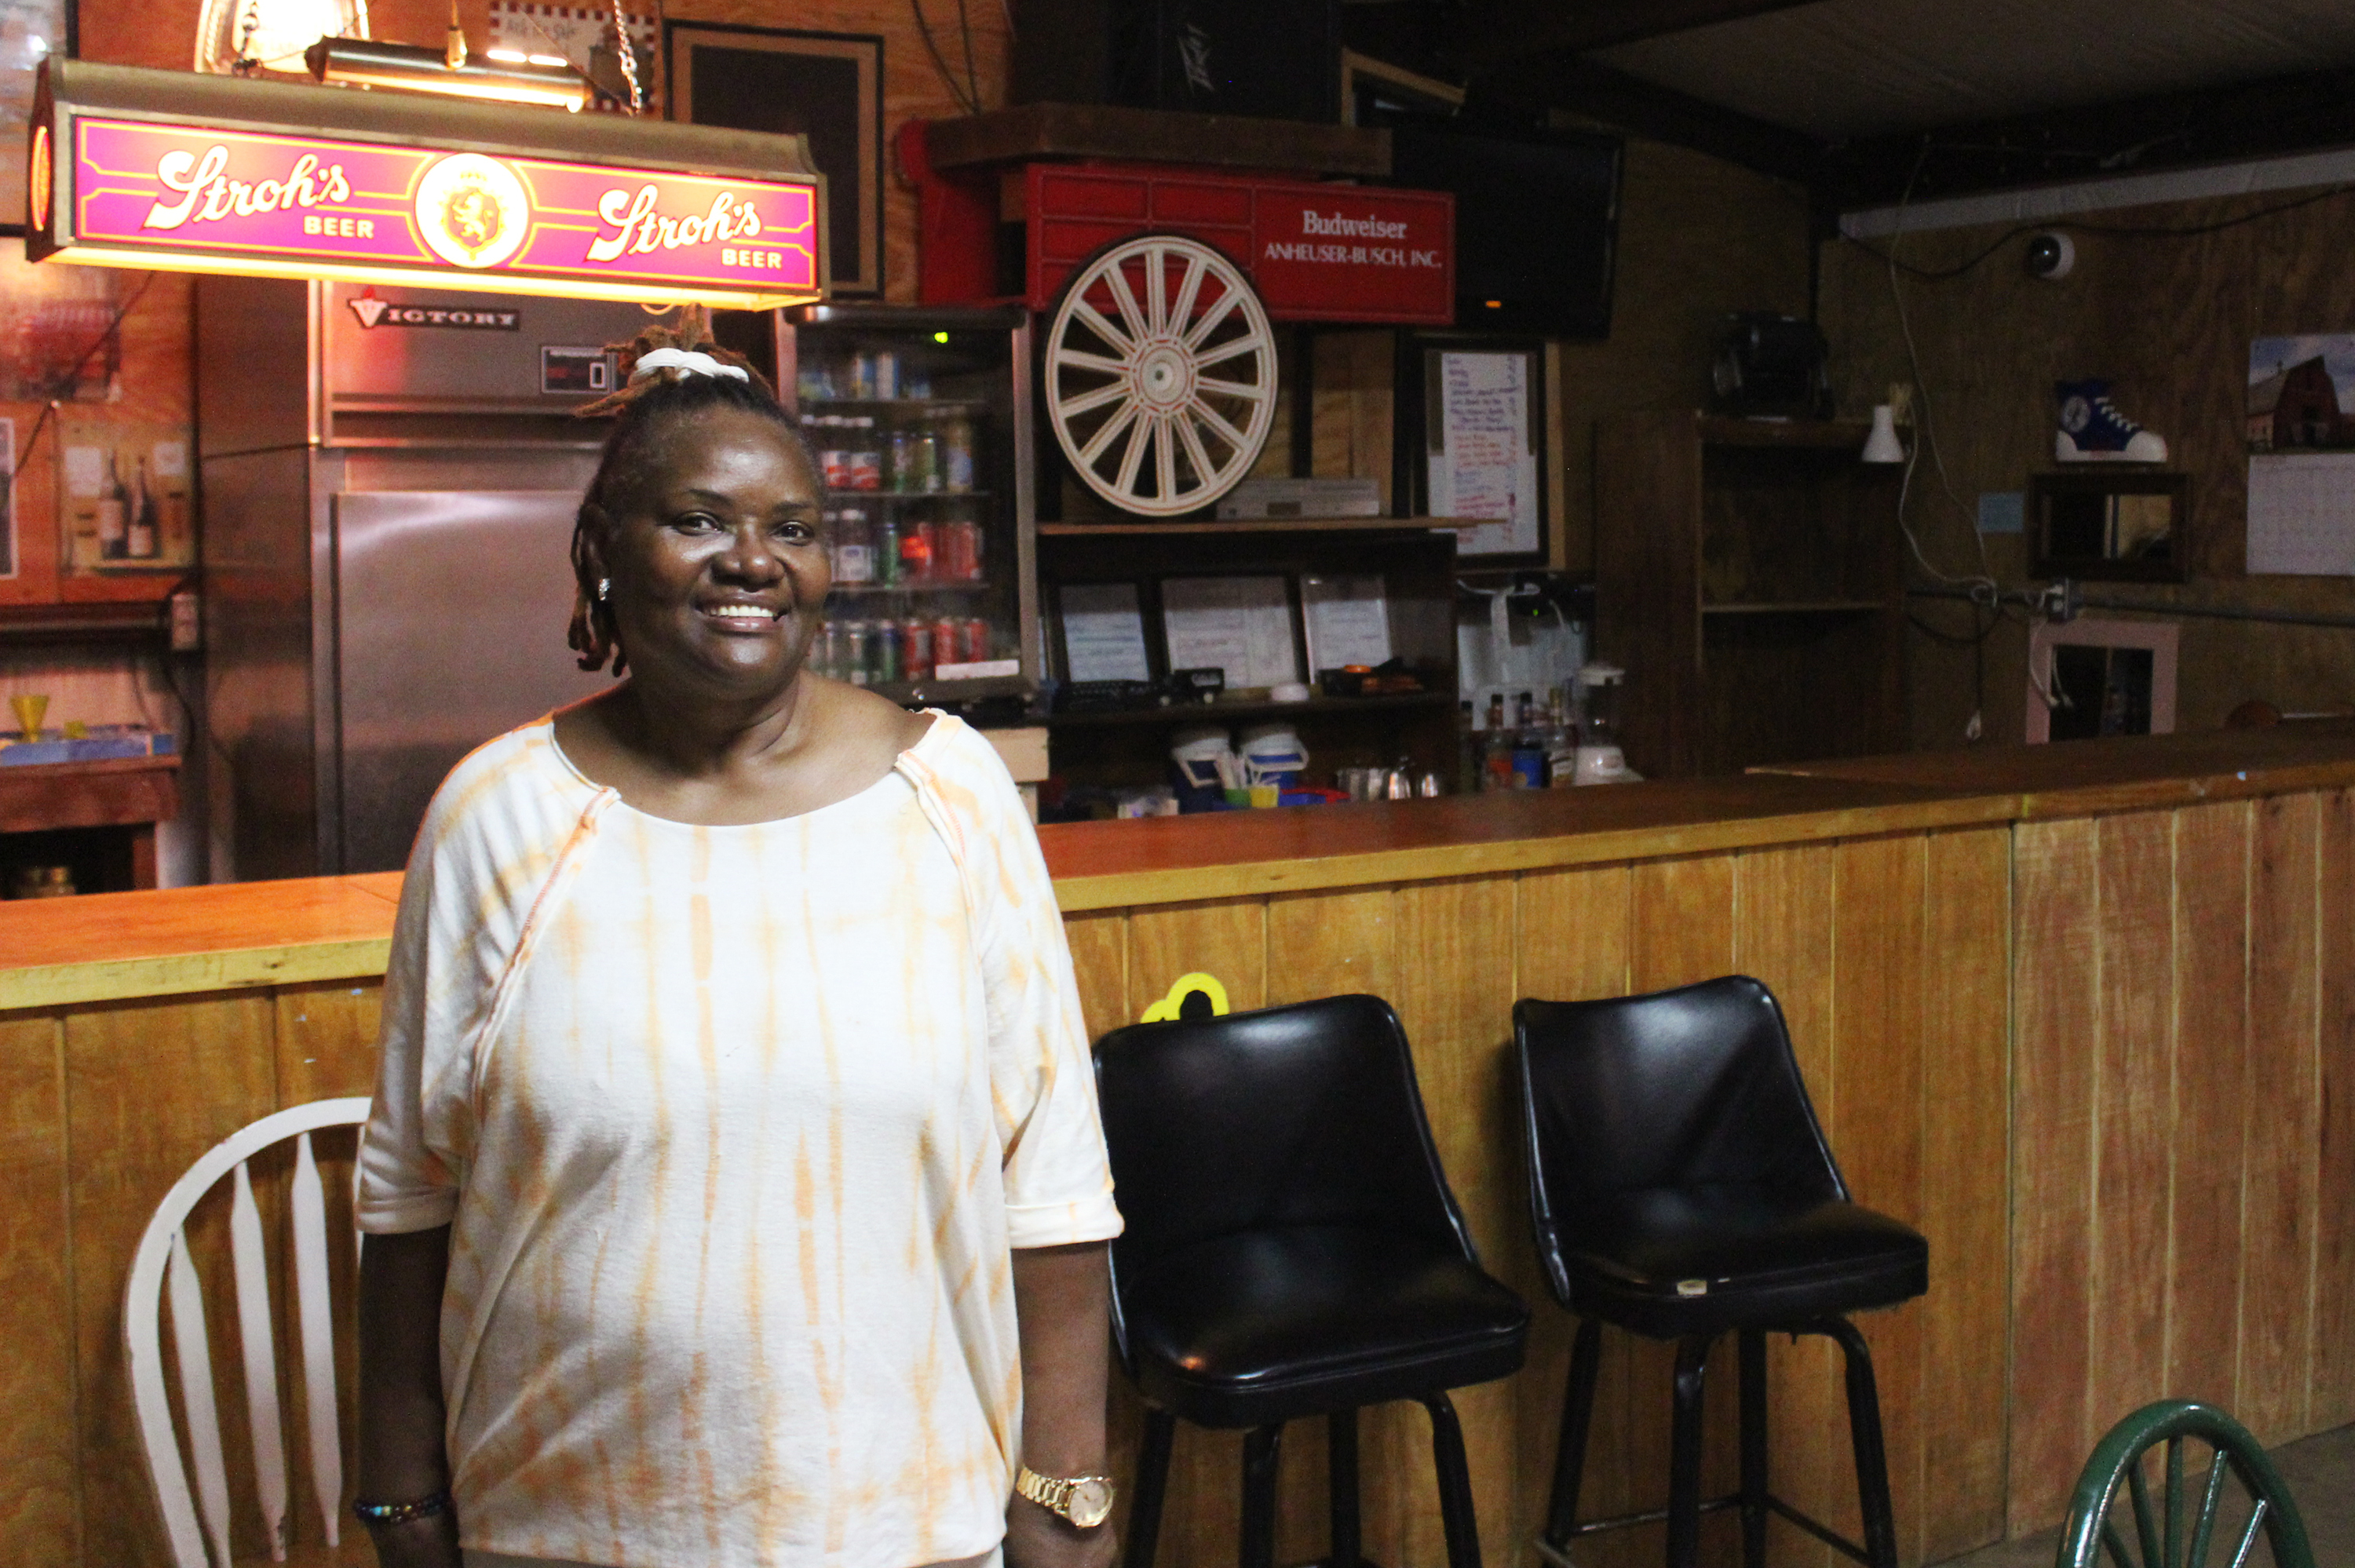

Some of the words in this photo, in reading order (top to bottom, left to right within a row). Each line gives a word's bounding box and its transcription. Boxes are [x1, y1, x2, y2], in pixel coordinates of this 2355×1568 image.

[141, 144, 351, 230] Stroh's
[303, 214, 374, 239] BEER
[584, 184, 761, 262] Stroh's
[1302, 210, 1408, 239] Budweiser
[721, 247, 783, 269] BEER
[1411, 249, 1443, 268] INC.
[349, 298, 515, 327] VICTORY
